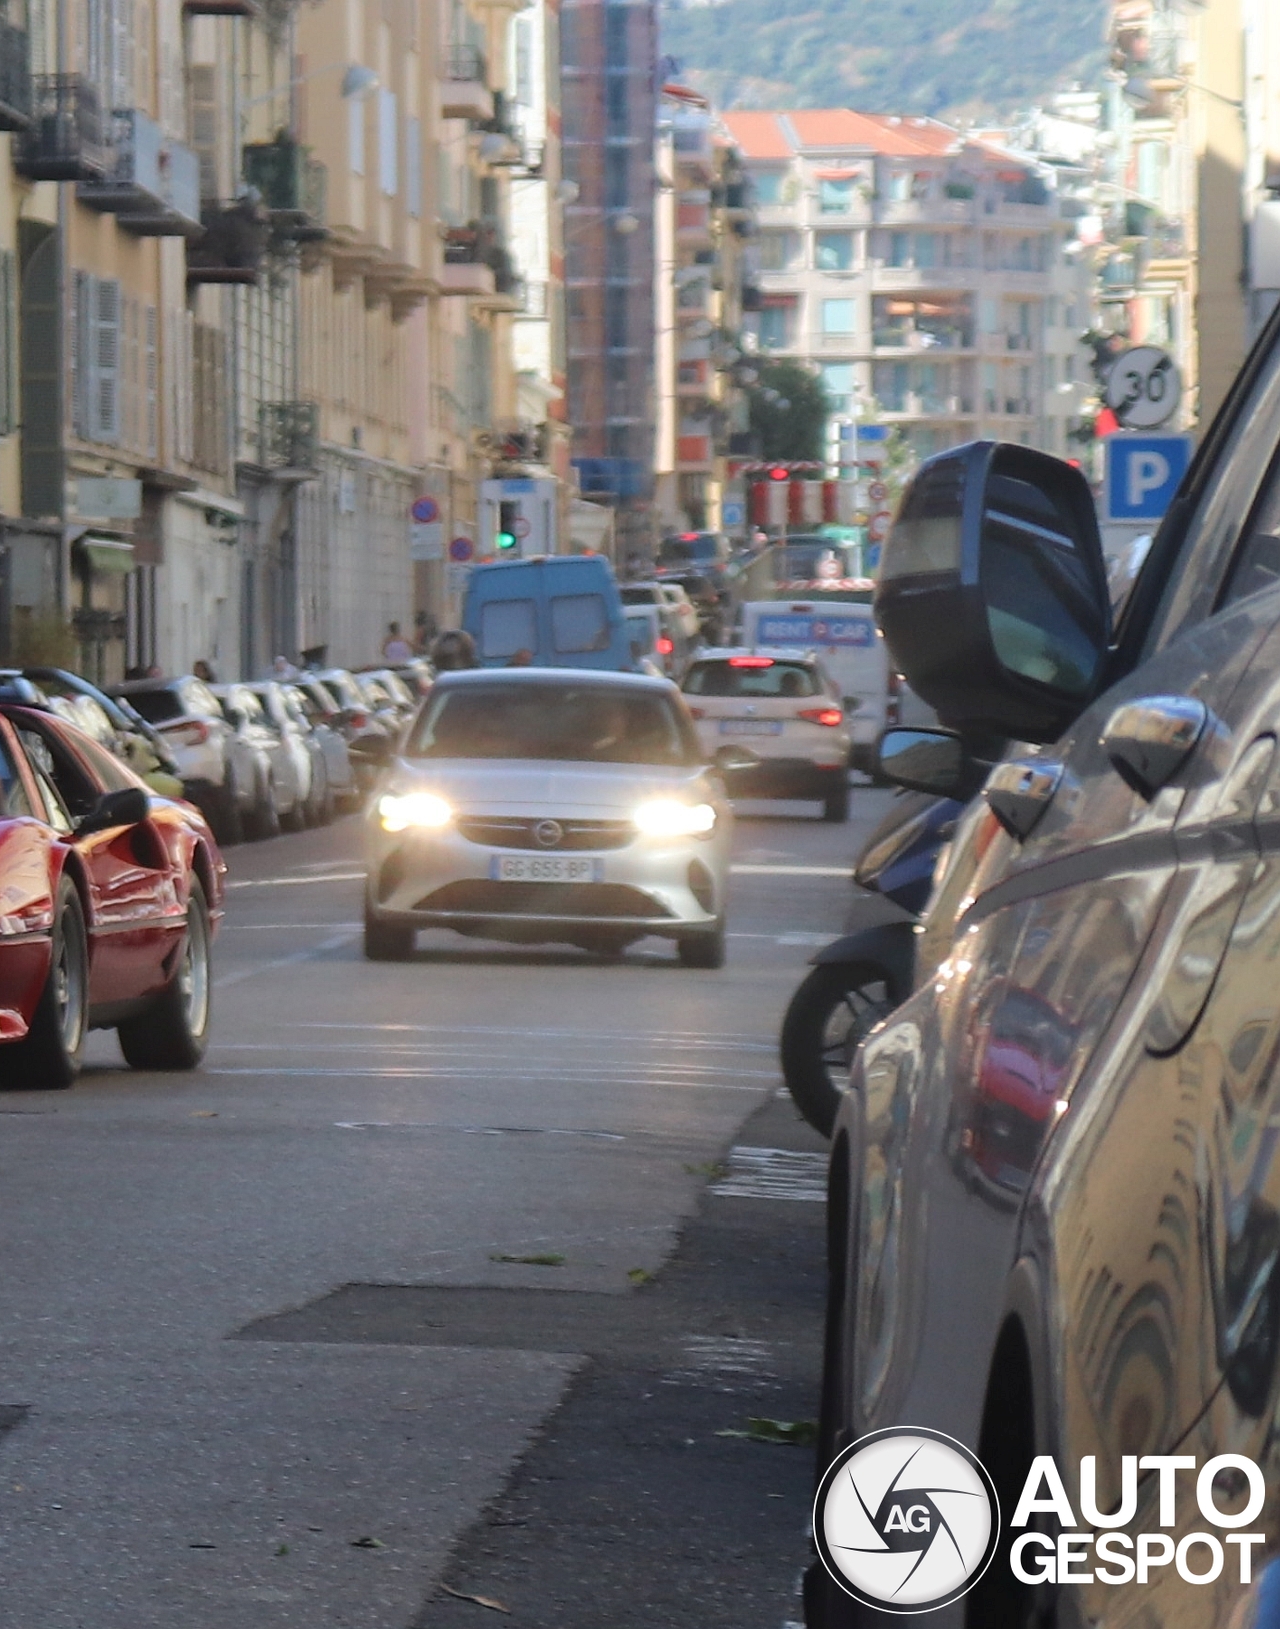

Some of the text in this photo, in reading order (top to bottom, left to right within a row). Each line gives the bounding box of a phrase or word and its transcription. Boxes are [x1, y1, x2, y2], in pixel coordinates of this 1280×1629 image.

[1126, 370, 1163, 402] 30
[1128, 451, 1169, 505] P
[764, 621, 809, 637] RENT
[833, 623, 869, 638] CAR
